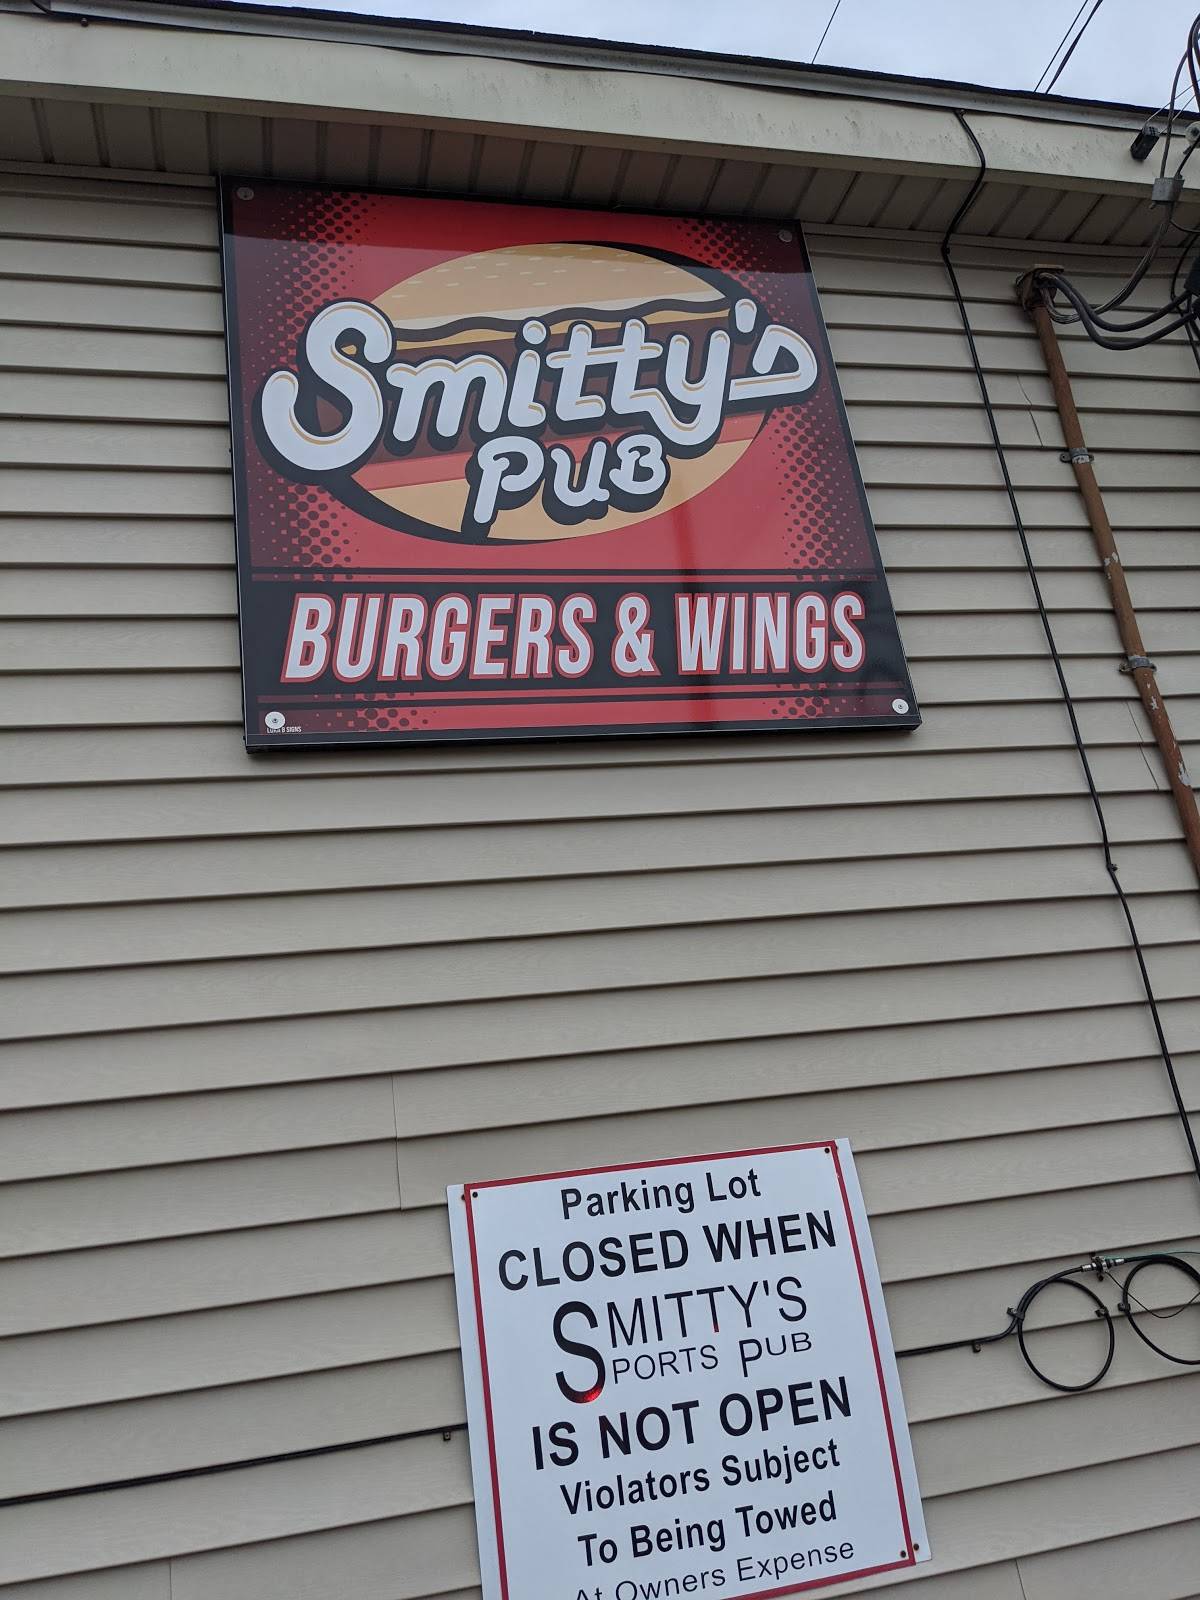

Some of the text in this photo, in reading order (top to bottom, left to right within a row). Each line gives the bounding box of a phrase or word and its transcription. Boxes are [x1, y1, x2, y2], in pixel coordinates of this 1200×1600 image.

[261, 298, 819, 471] Smitty's
[280, 590, 867, 683] BURGERS & WINGS
[561, 1168, 762, 1220] Parking Lot
[499, 1210, 837, 1290] CLOSED WHEN
[532, 1375, 852, 1471] IS NOT OPEN
[560, 1438, 841, 1515] Violators Subject
[577, 1490, 837, 1567] To Being Towed
[616, 1567, 726, 1600] Owners
[736, 1542, 854, 1582] Expense
